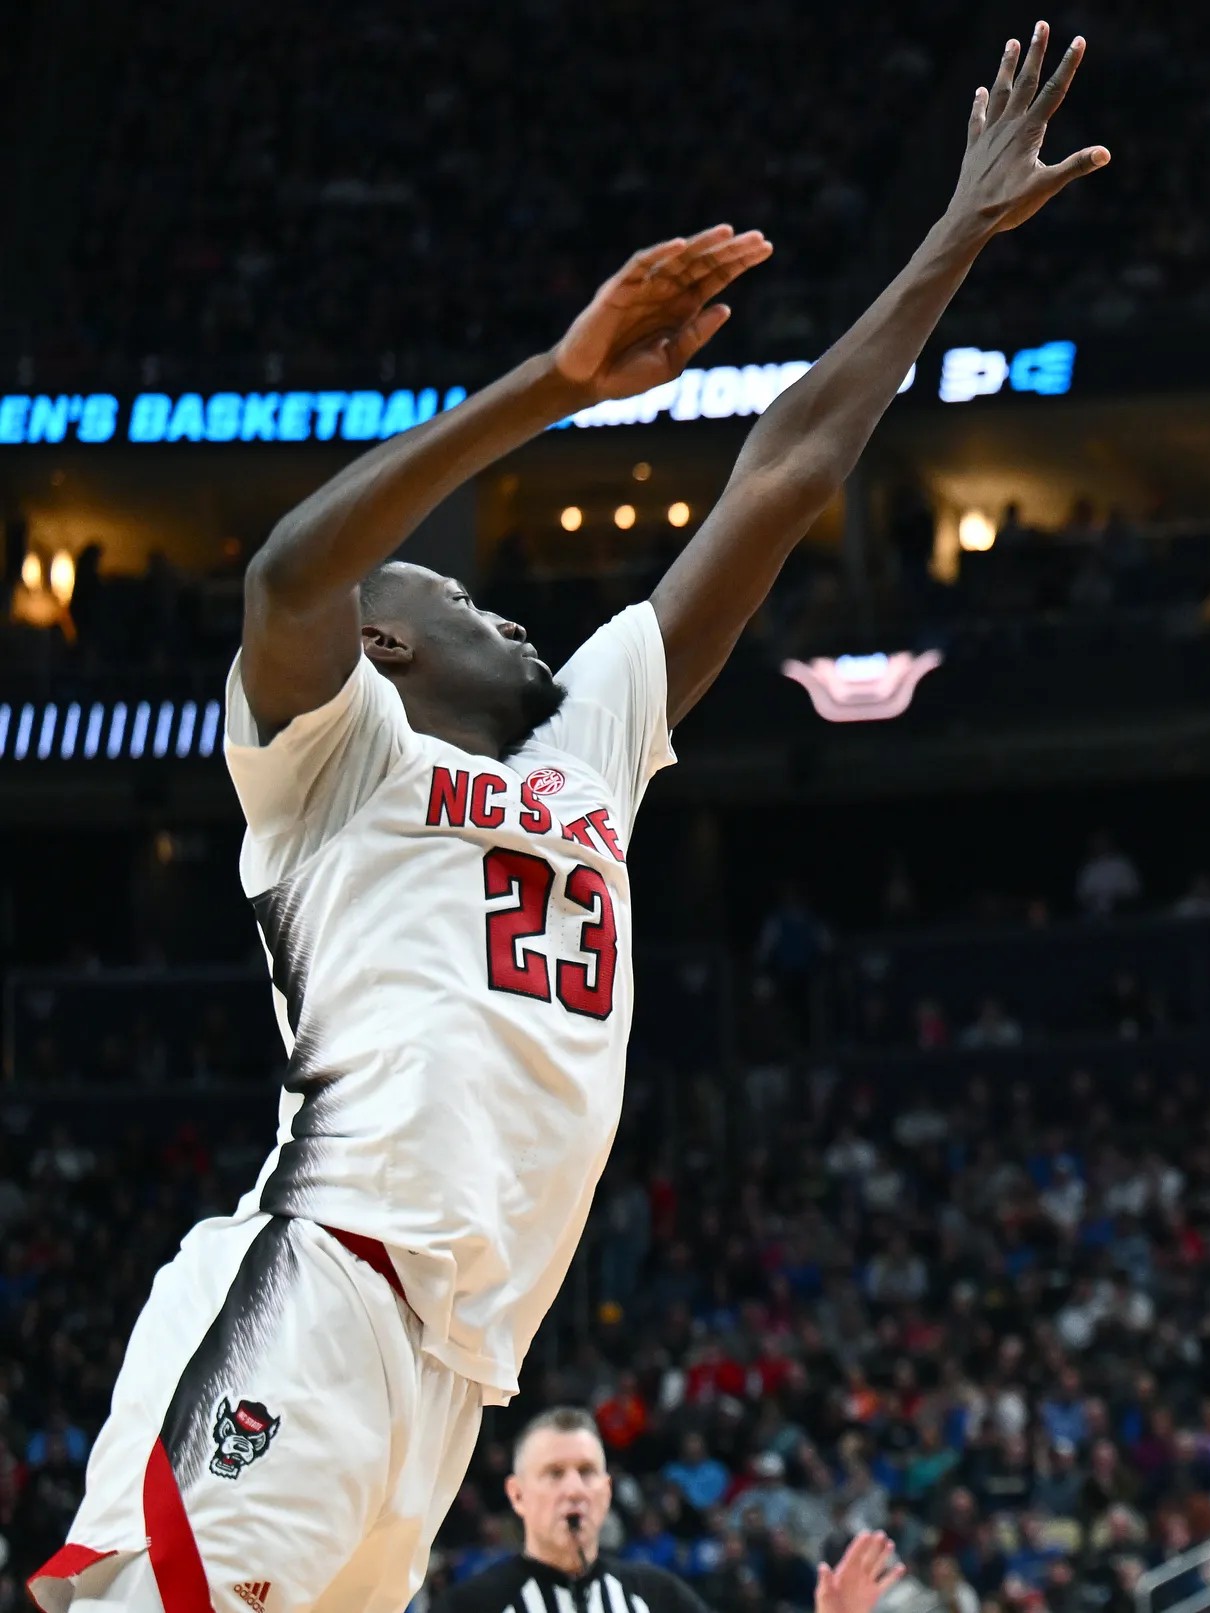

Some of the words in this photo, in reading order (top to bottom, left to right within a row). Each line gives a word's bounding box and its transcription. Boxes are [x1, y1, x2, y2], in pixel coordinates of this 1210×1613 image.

[128, 386, 468, 442] BASKETBA
[425, 766, 507, 829] NC
[483, 846, 618, 1021] 23
[234, 1584, 266, 1613] adidas
